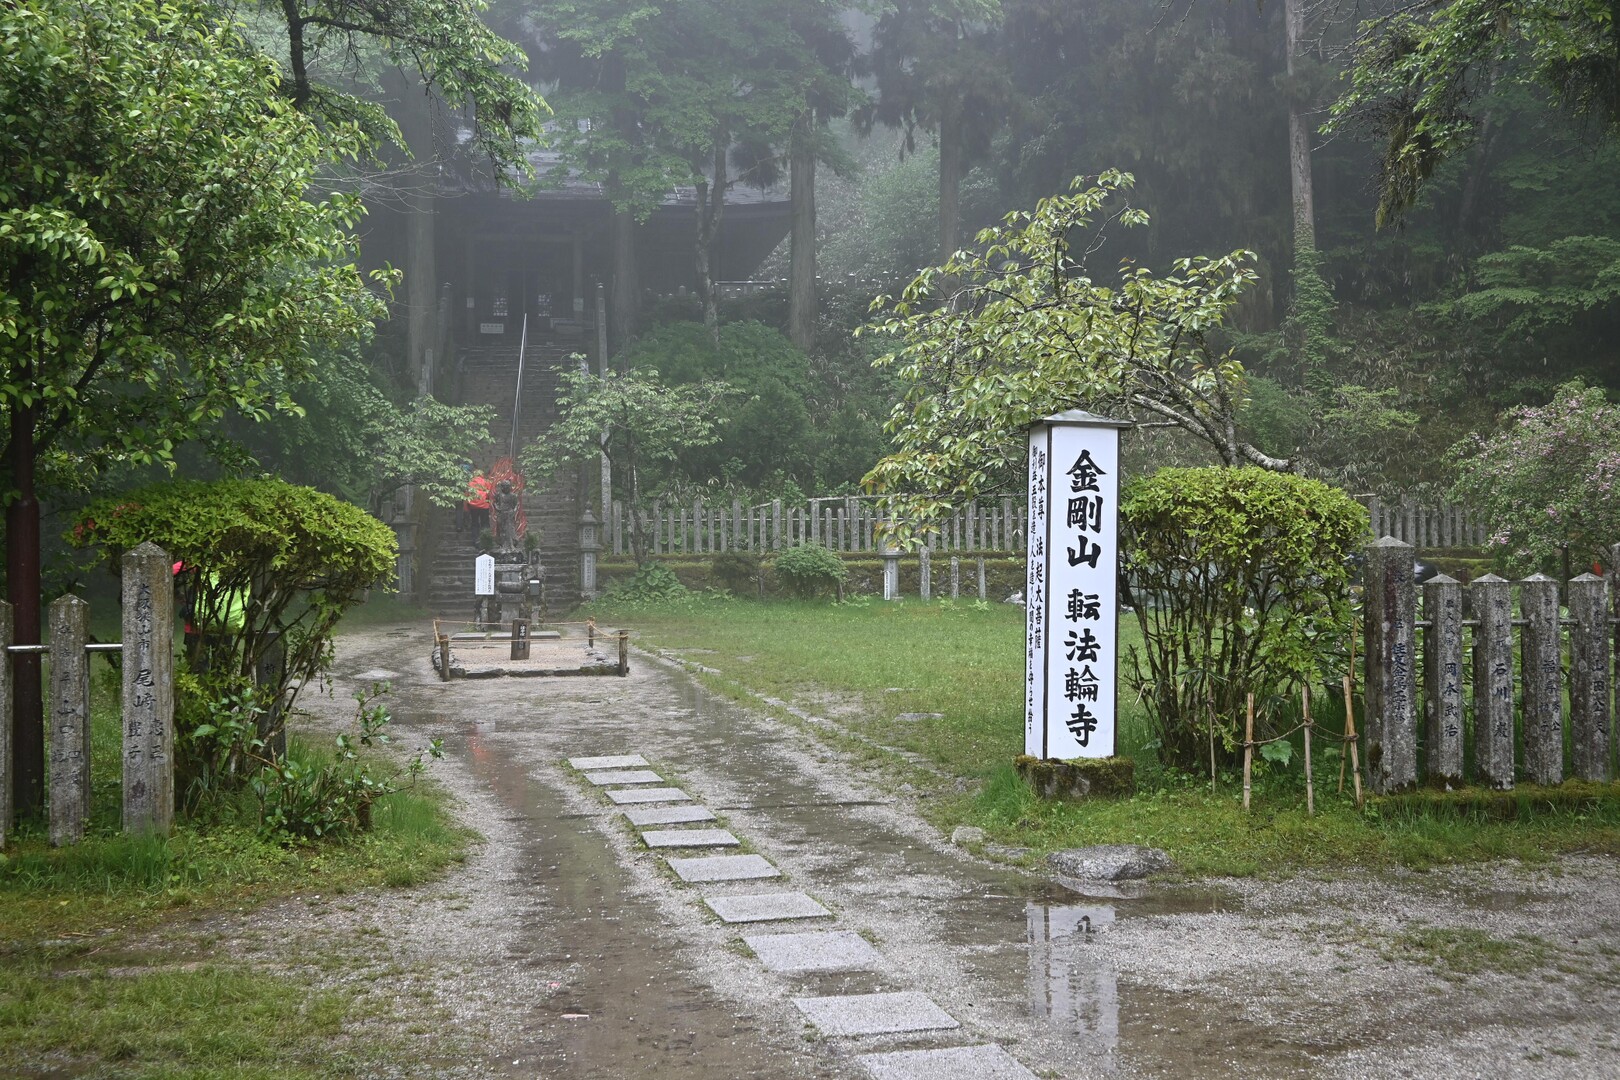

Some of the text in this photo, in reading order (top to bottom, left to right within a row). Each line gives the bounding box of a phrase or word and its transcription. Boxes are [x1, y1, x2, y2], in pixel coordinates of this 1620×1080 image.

[1034, 535, 1044, 649] 法起大菩薩
[1064, 449, 1107, 748] 金剛山 転法輪寺
[57, 699, 76, 734] 山口
